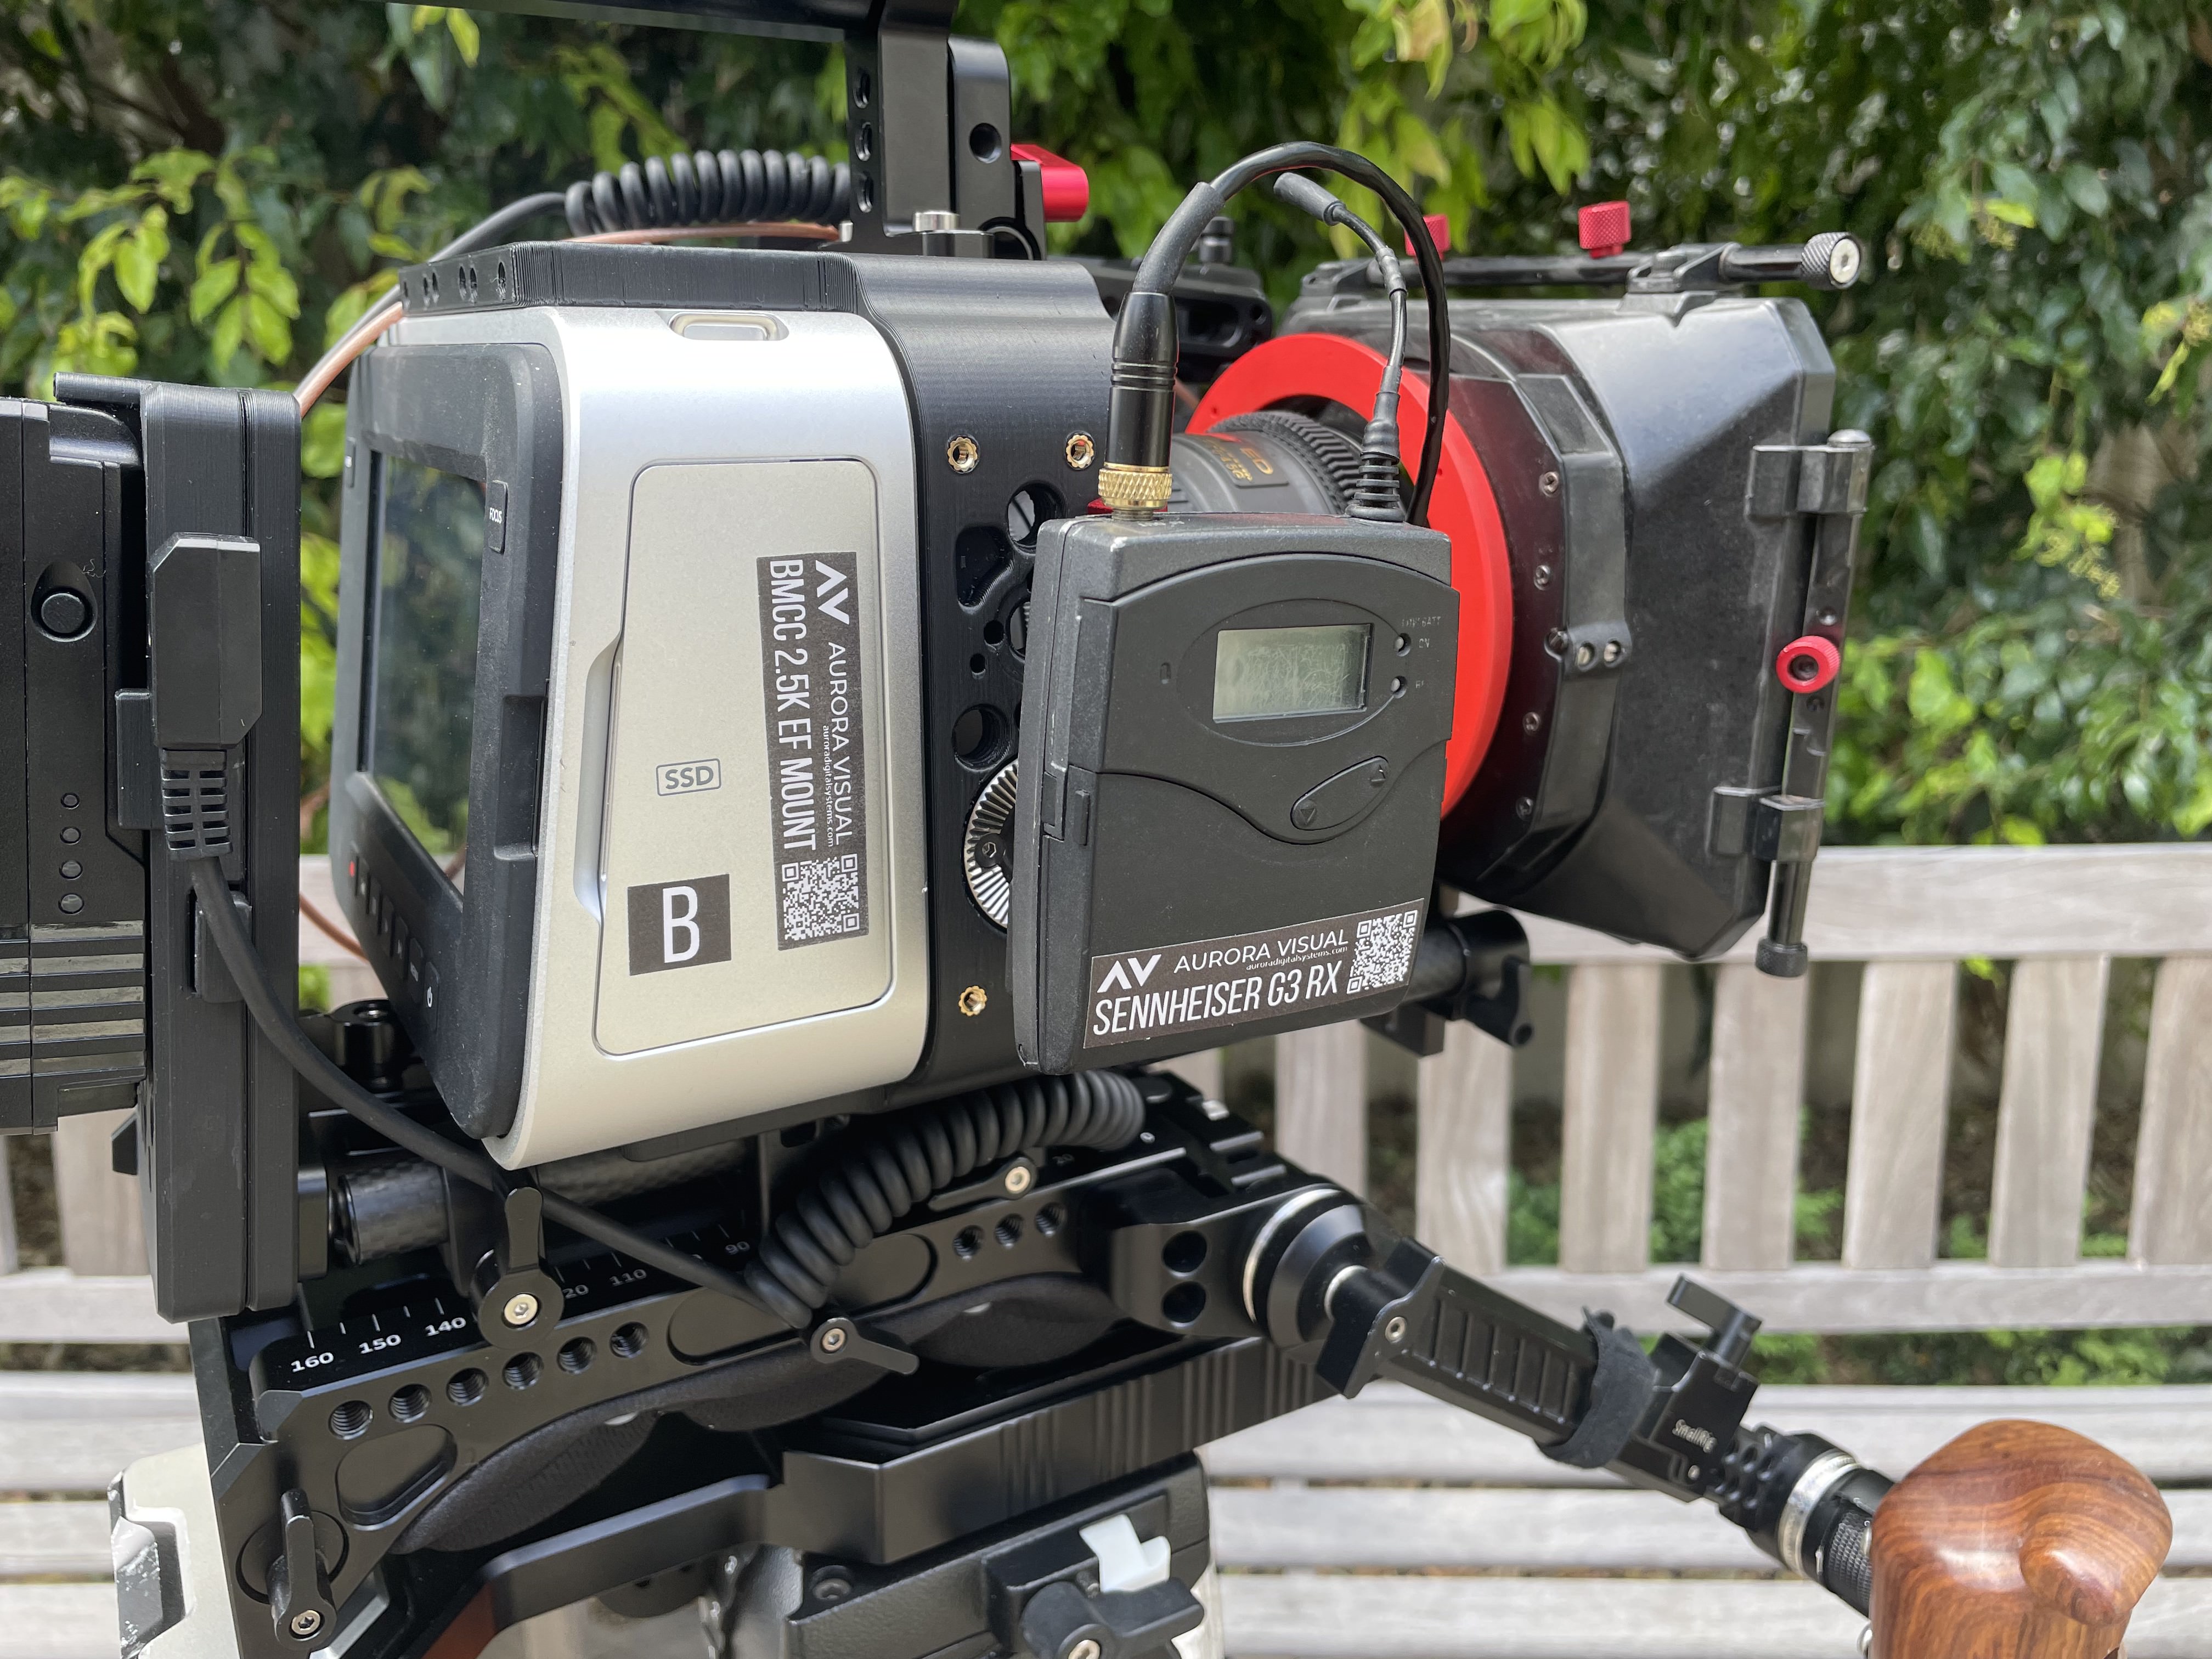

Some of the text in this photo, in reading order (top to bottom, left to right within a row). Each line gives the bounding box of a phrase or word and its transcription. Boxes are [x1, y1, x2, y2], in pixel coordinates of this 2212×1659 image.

[1239, 447, 1273, 475] ED
[489, 507, 503, 524] FOCUS
[770, 560, 816, 850] BMCC 2.5K EF MOUNT
[828, 642, 853, 845] AURORA VISUAL
[665, 766, 714, 789] SSD
[823, 725, 833, 847] auroradigitalsystems.com
[663, 885, 700, 963] B
[1173, 929, 1348, 973] AURORA VISUAL
[1246, 946, 1347, 970] auroradigitalsystems.com
[1093, 960, 1342, 1035] SENNHEISER G3 RX
[291, 1352, 334, 1373] 160
[358, 1334, 402, 1354] 150
[425, 1317, 466, 1336] 140
[562, 1284, 589, 1300] 20
[609, 1269, 647, 1286] 110
[725, 1241, 751, 1255] 90
[1672, 1419, 1717, 1453] SmallRig
